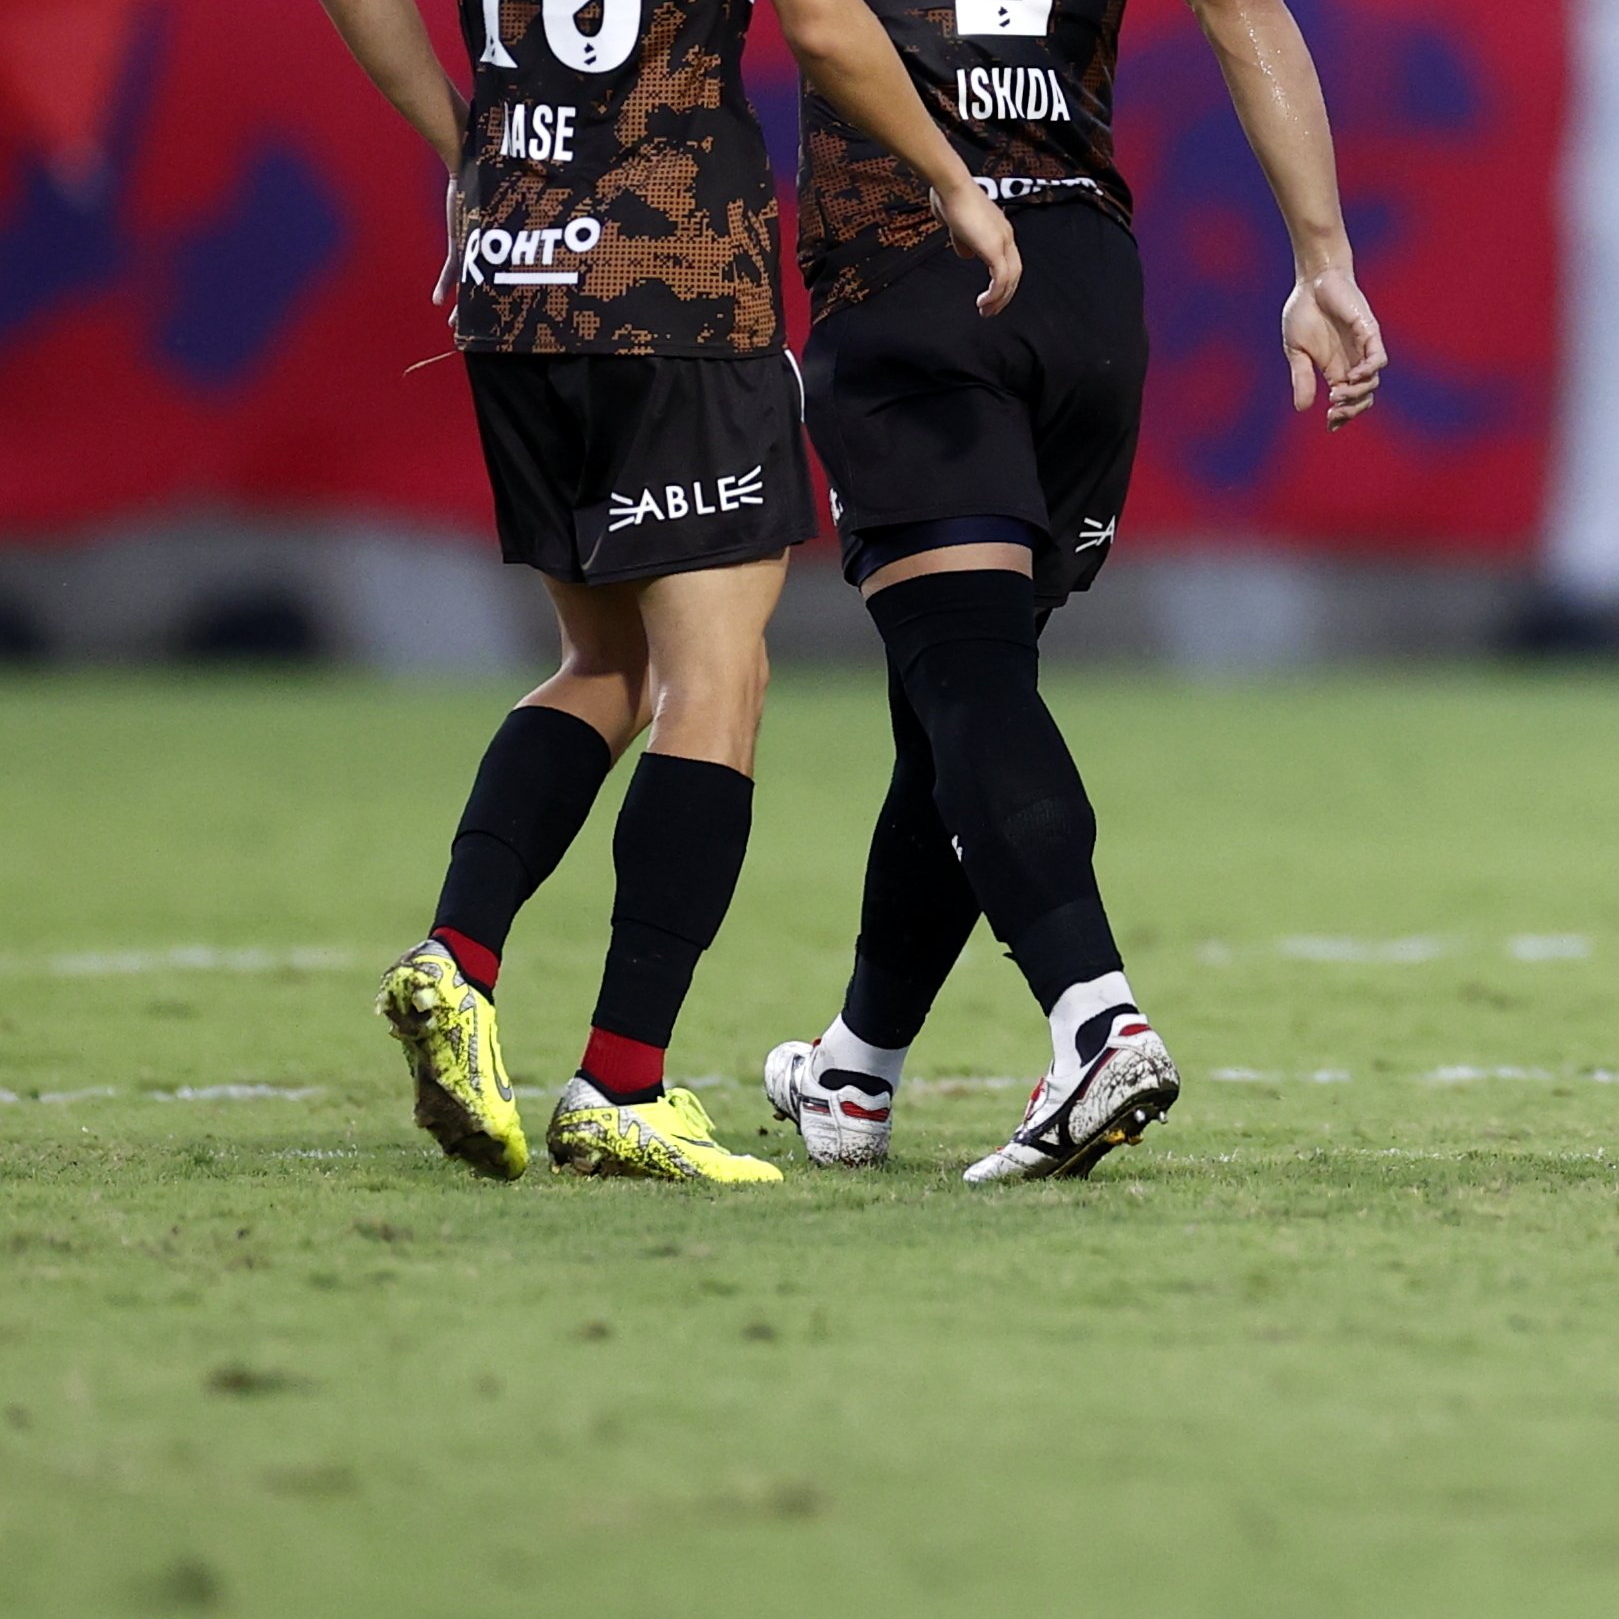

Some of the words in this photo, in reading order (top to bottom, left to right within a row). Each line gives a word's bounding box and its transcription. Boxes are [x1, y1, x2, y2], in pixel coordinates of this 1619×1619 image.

[956, 67, 1071, 121] ISHIDA
[501, 101, 577, 162] ASE
[462, 217, 601, 286] ROHTO
[608, 465, 764, 532] ABLE
